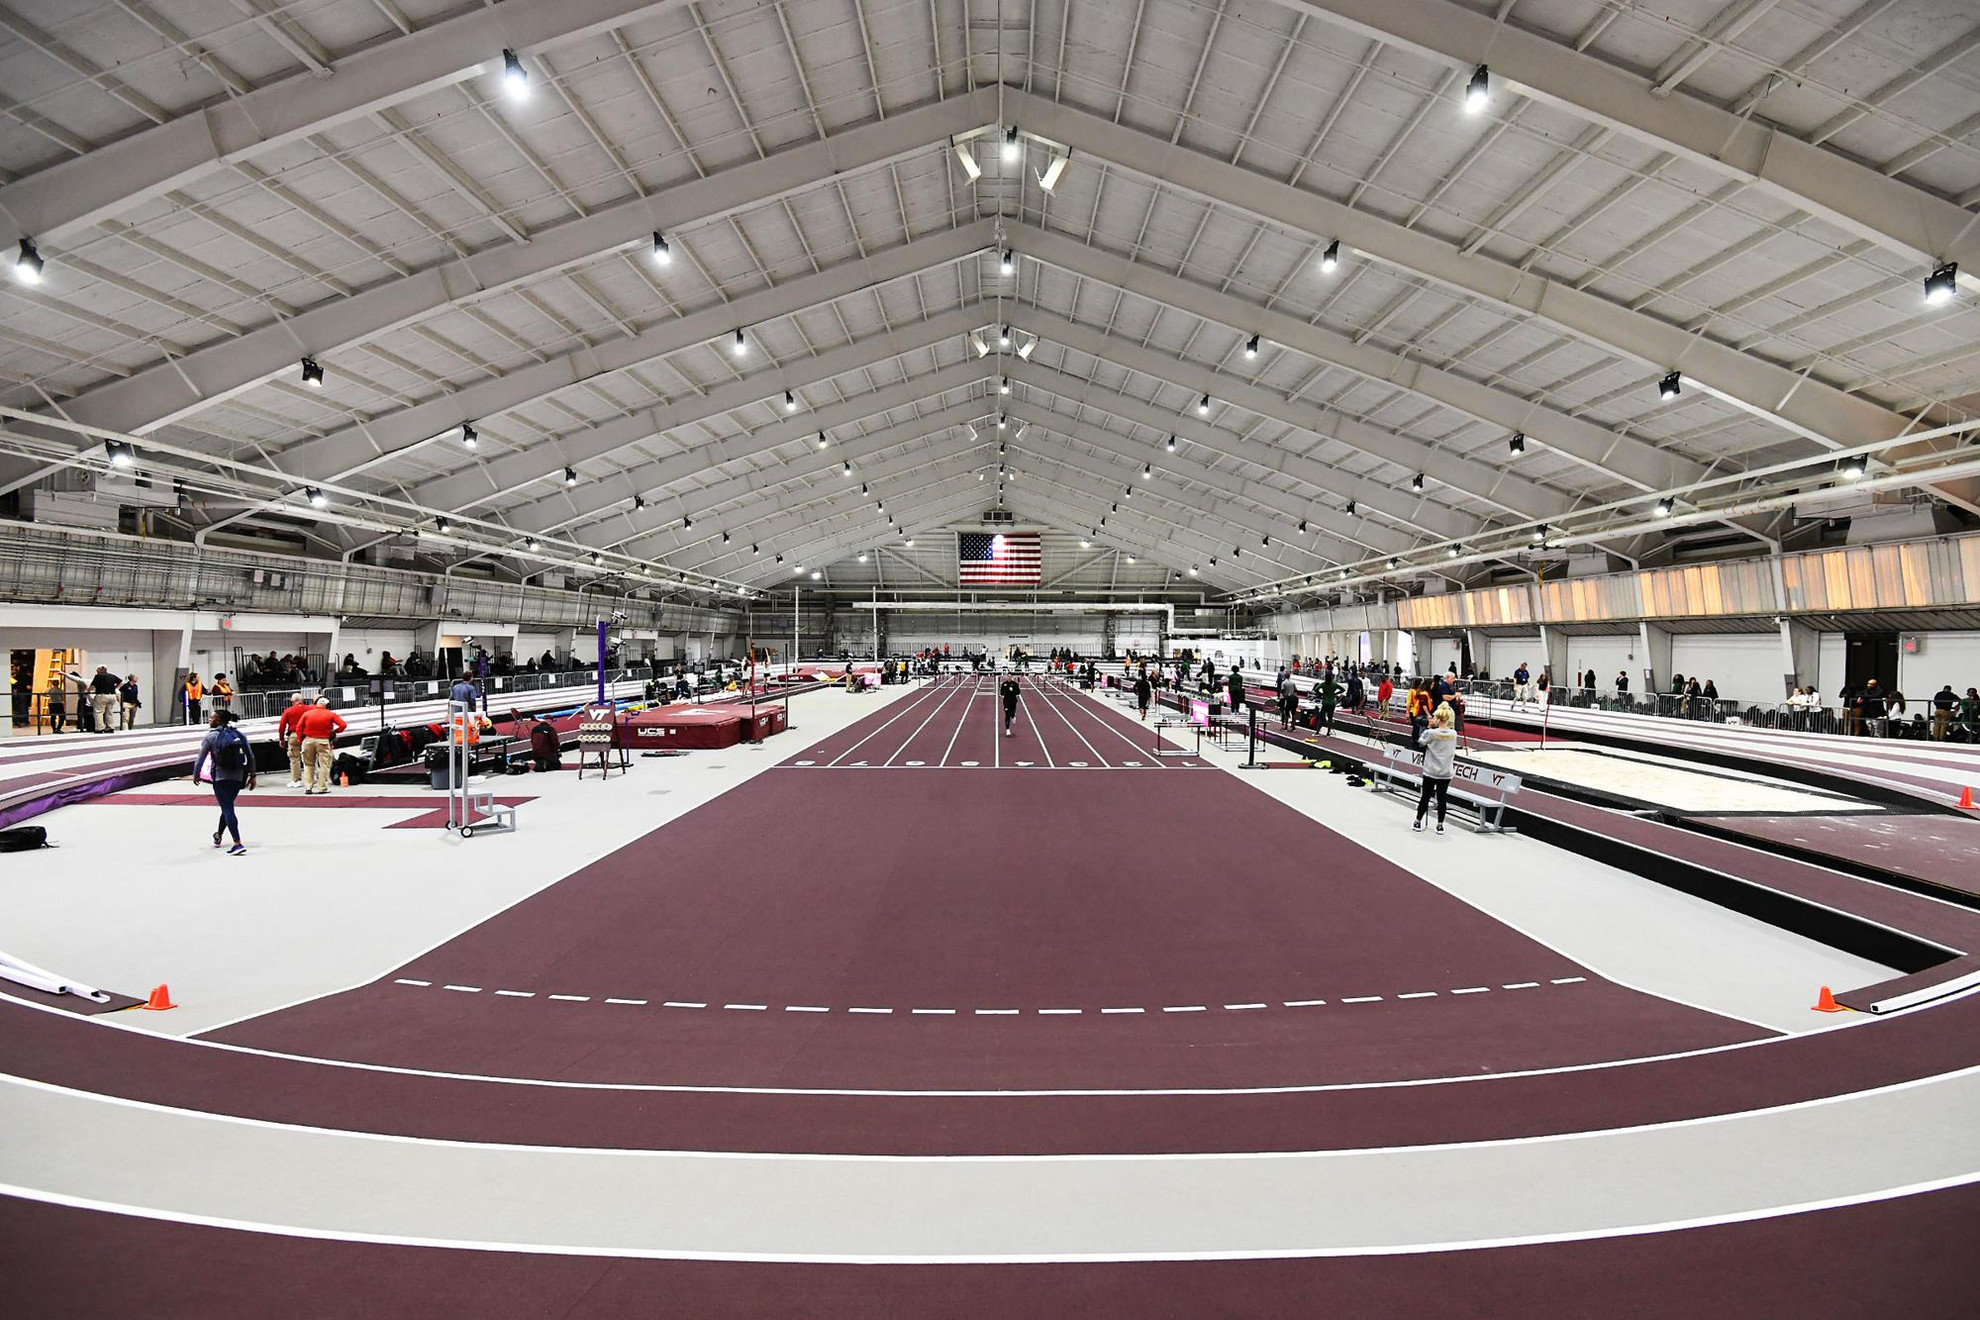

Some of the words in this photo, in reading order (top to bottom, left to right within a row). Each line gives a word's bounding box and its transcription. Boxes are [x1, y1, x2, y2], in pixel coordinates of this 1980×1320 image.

[589, 709, 611, 720] VT
[1393, 749, 1401, 758] VT
[1493, 773, 1505, 786] VT
